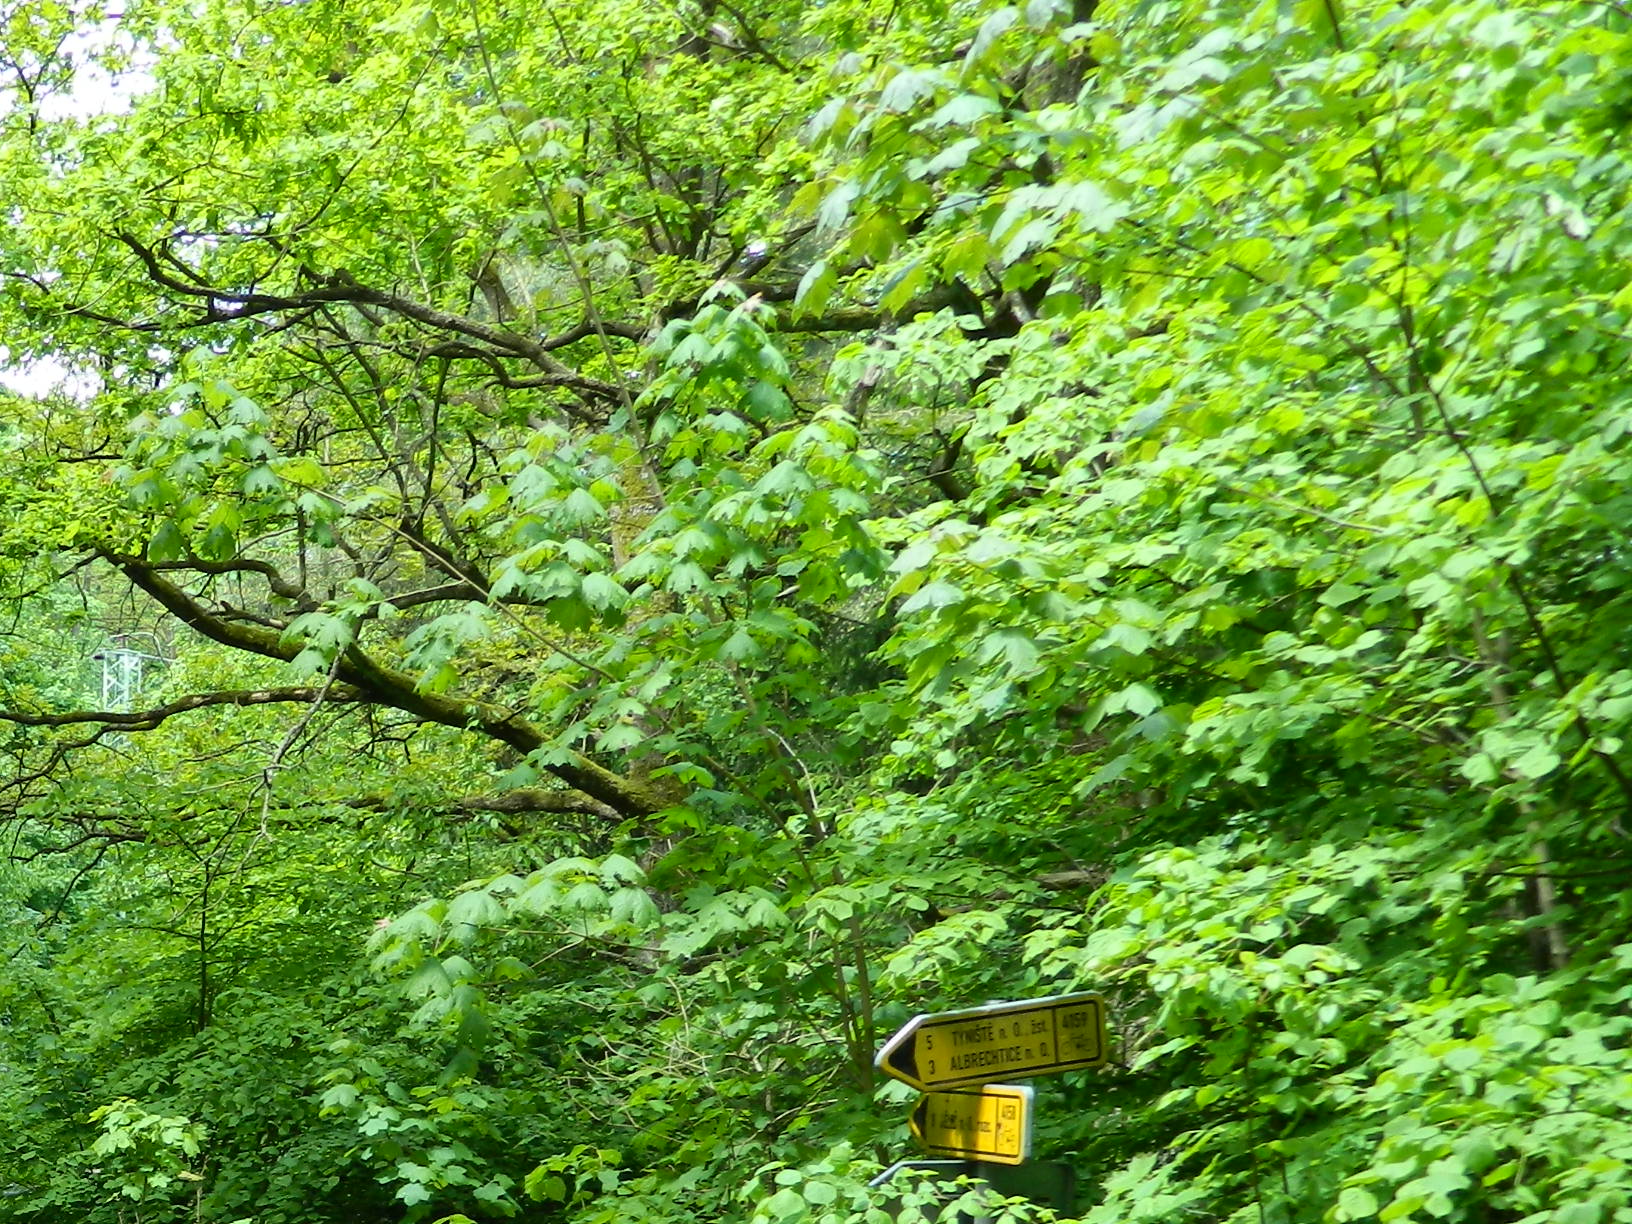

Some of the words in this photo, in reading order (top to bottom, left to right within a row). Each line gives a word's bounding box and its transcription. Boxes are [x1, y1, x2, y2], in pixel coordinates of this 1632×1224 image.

[925, 1034, 933, 1050] 5
[928, 1059, 936, 1075] 3
[950, 1046, 1022, 1072] ALBRECHTICE
